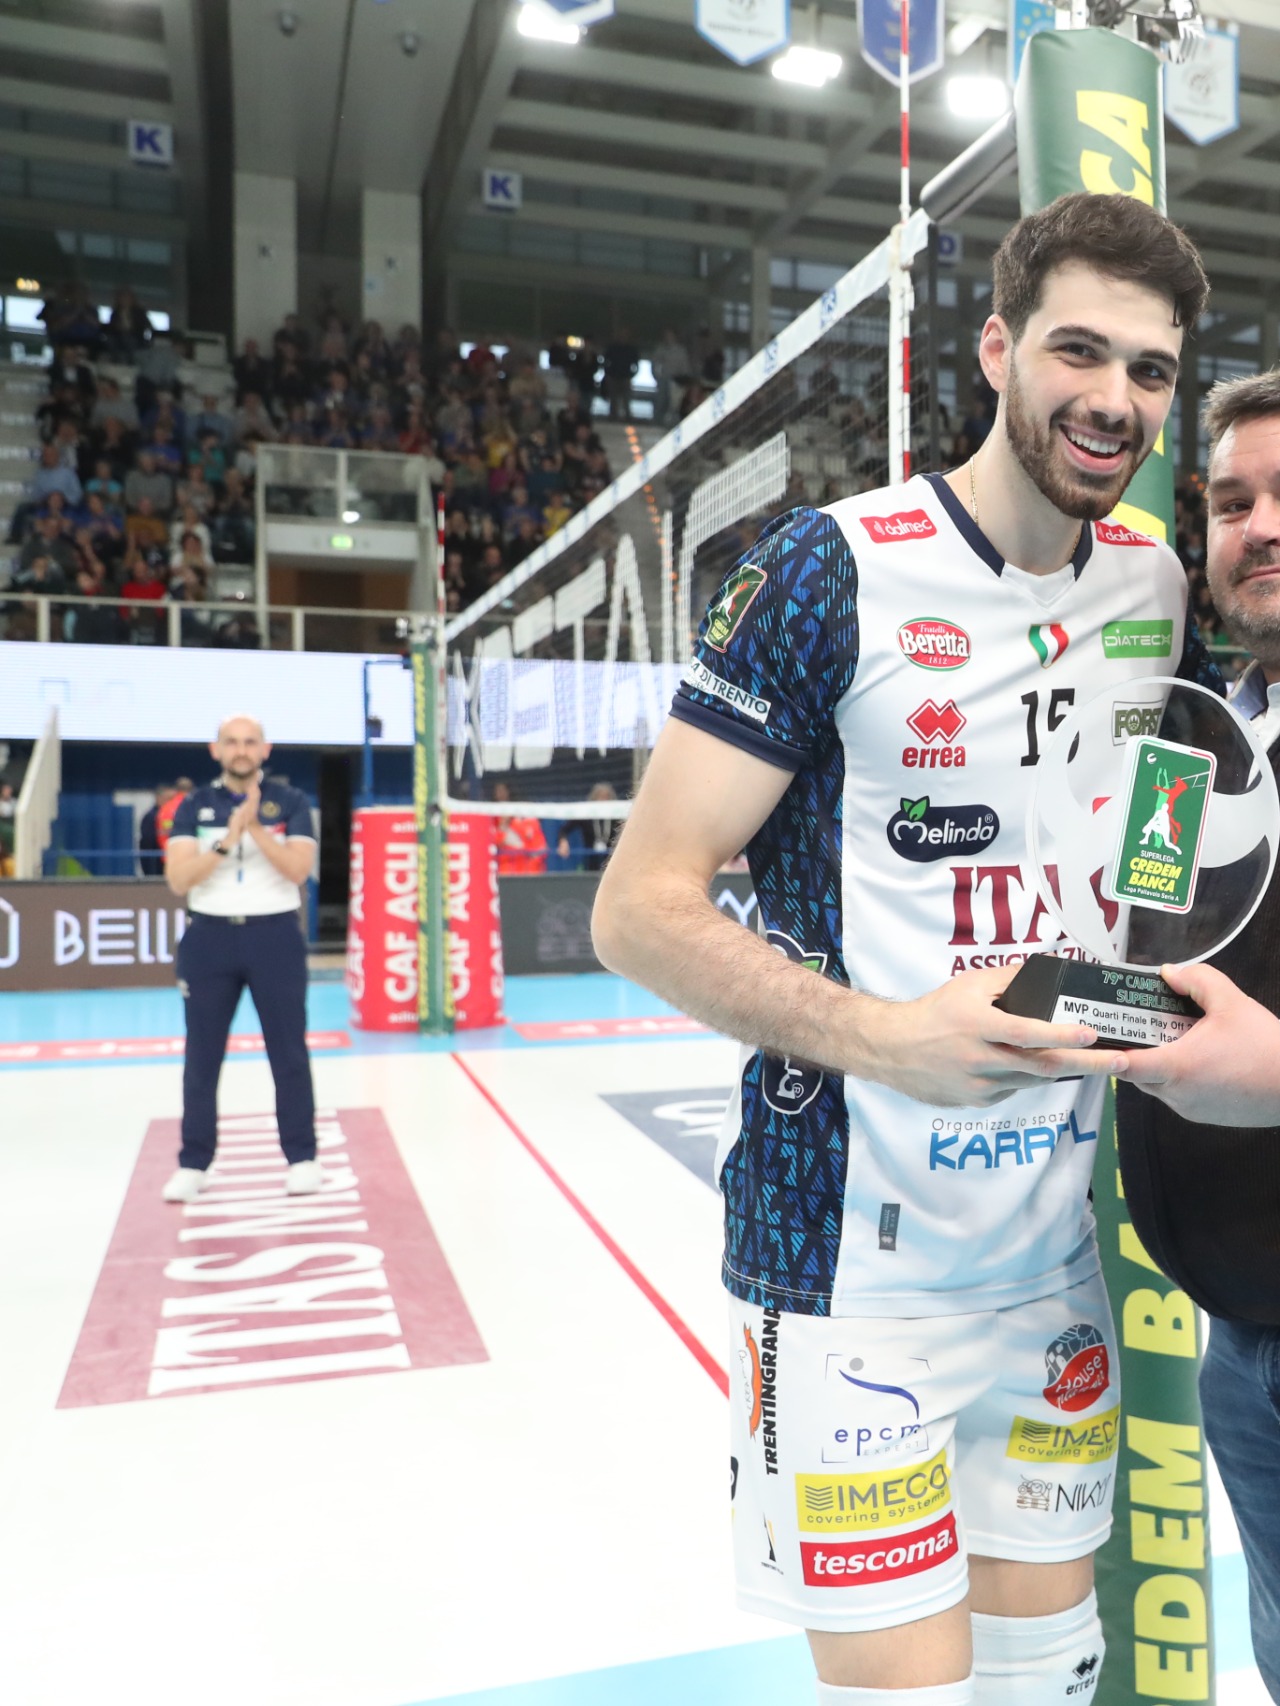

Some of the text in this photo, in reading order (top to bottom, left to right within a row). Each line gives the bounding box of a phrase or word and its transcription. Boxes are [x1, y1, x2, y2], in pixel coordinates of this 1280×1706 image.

[134, 127, 163, 155] K
[489, 174, 512, 198] K
[884, 514, 934, 537] dalmec
[918, 623, 946, 634] Fratelli
[899, 628, 969, 658] Beretta
[929, 657, 948, 665] 1812
[699, 671, 712, 687] DI
[712, 679, 768, 714] TRENTO
[901, 745, 966, 769] errea
[893, 816, 995, 845] Melinda
[1129, 857, 1183, 880] CREDEM
[1140, 849, 1175, 864] SUPERLEGA
[384, 842, 419, 922] ACLI
[1123, 885, 1137, 894] Lega
[1137, 887, 1161, 898] Pallavolo
[1161, 892, 1175, 901] Serie
[1128, 871, 1176, 893] BANCA
[384, 931, 419, 1002] CAF
[1116, 988, 1185, 1013] SUPERLEGA
[1064, 1000, 1089, 1016] MVP
[1092, 1007, 1119, 1021] Quarti
[1122, 1012, 1147, 1025] Finale
[1150, 1017, 1168, 1030] Play
[1170, 1021, 1185, 1031] Off
[1120, 1025, 1147, 1040] Lavia
[931, 1117, 1011, 1134] Organizza
[1016, 1117, 1027, 1128] lo
[147, 1241, 412, 1397] ITAS
[1018, 1444, 1081, 1458] covering
[837, 1463, 948, 1511] IMECO
[807, 1490, 946, 1524] covering systems
[813, 1529, 950, 1575] tescoma
